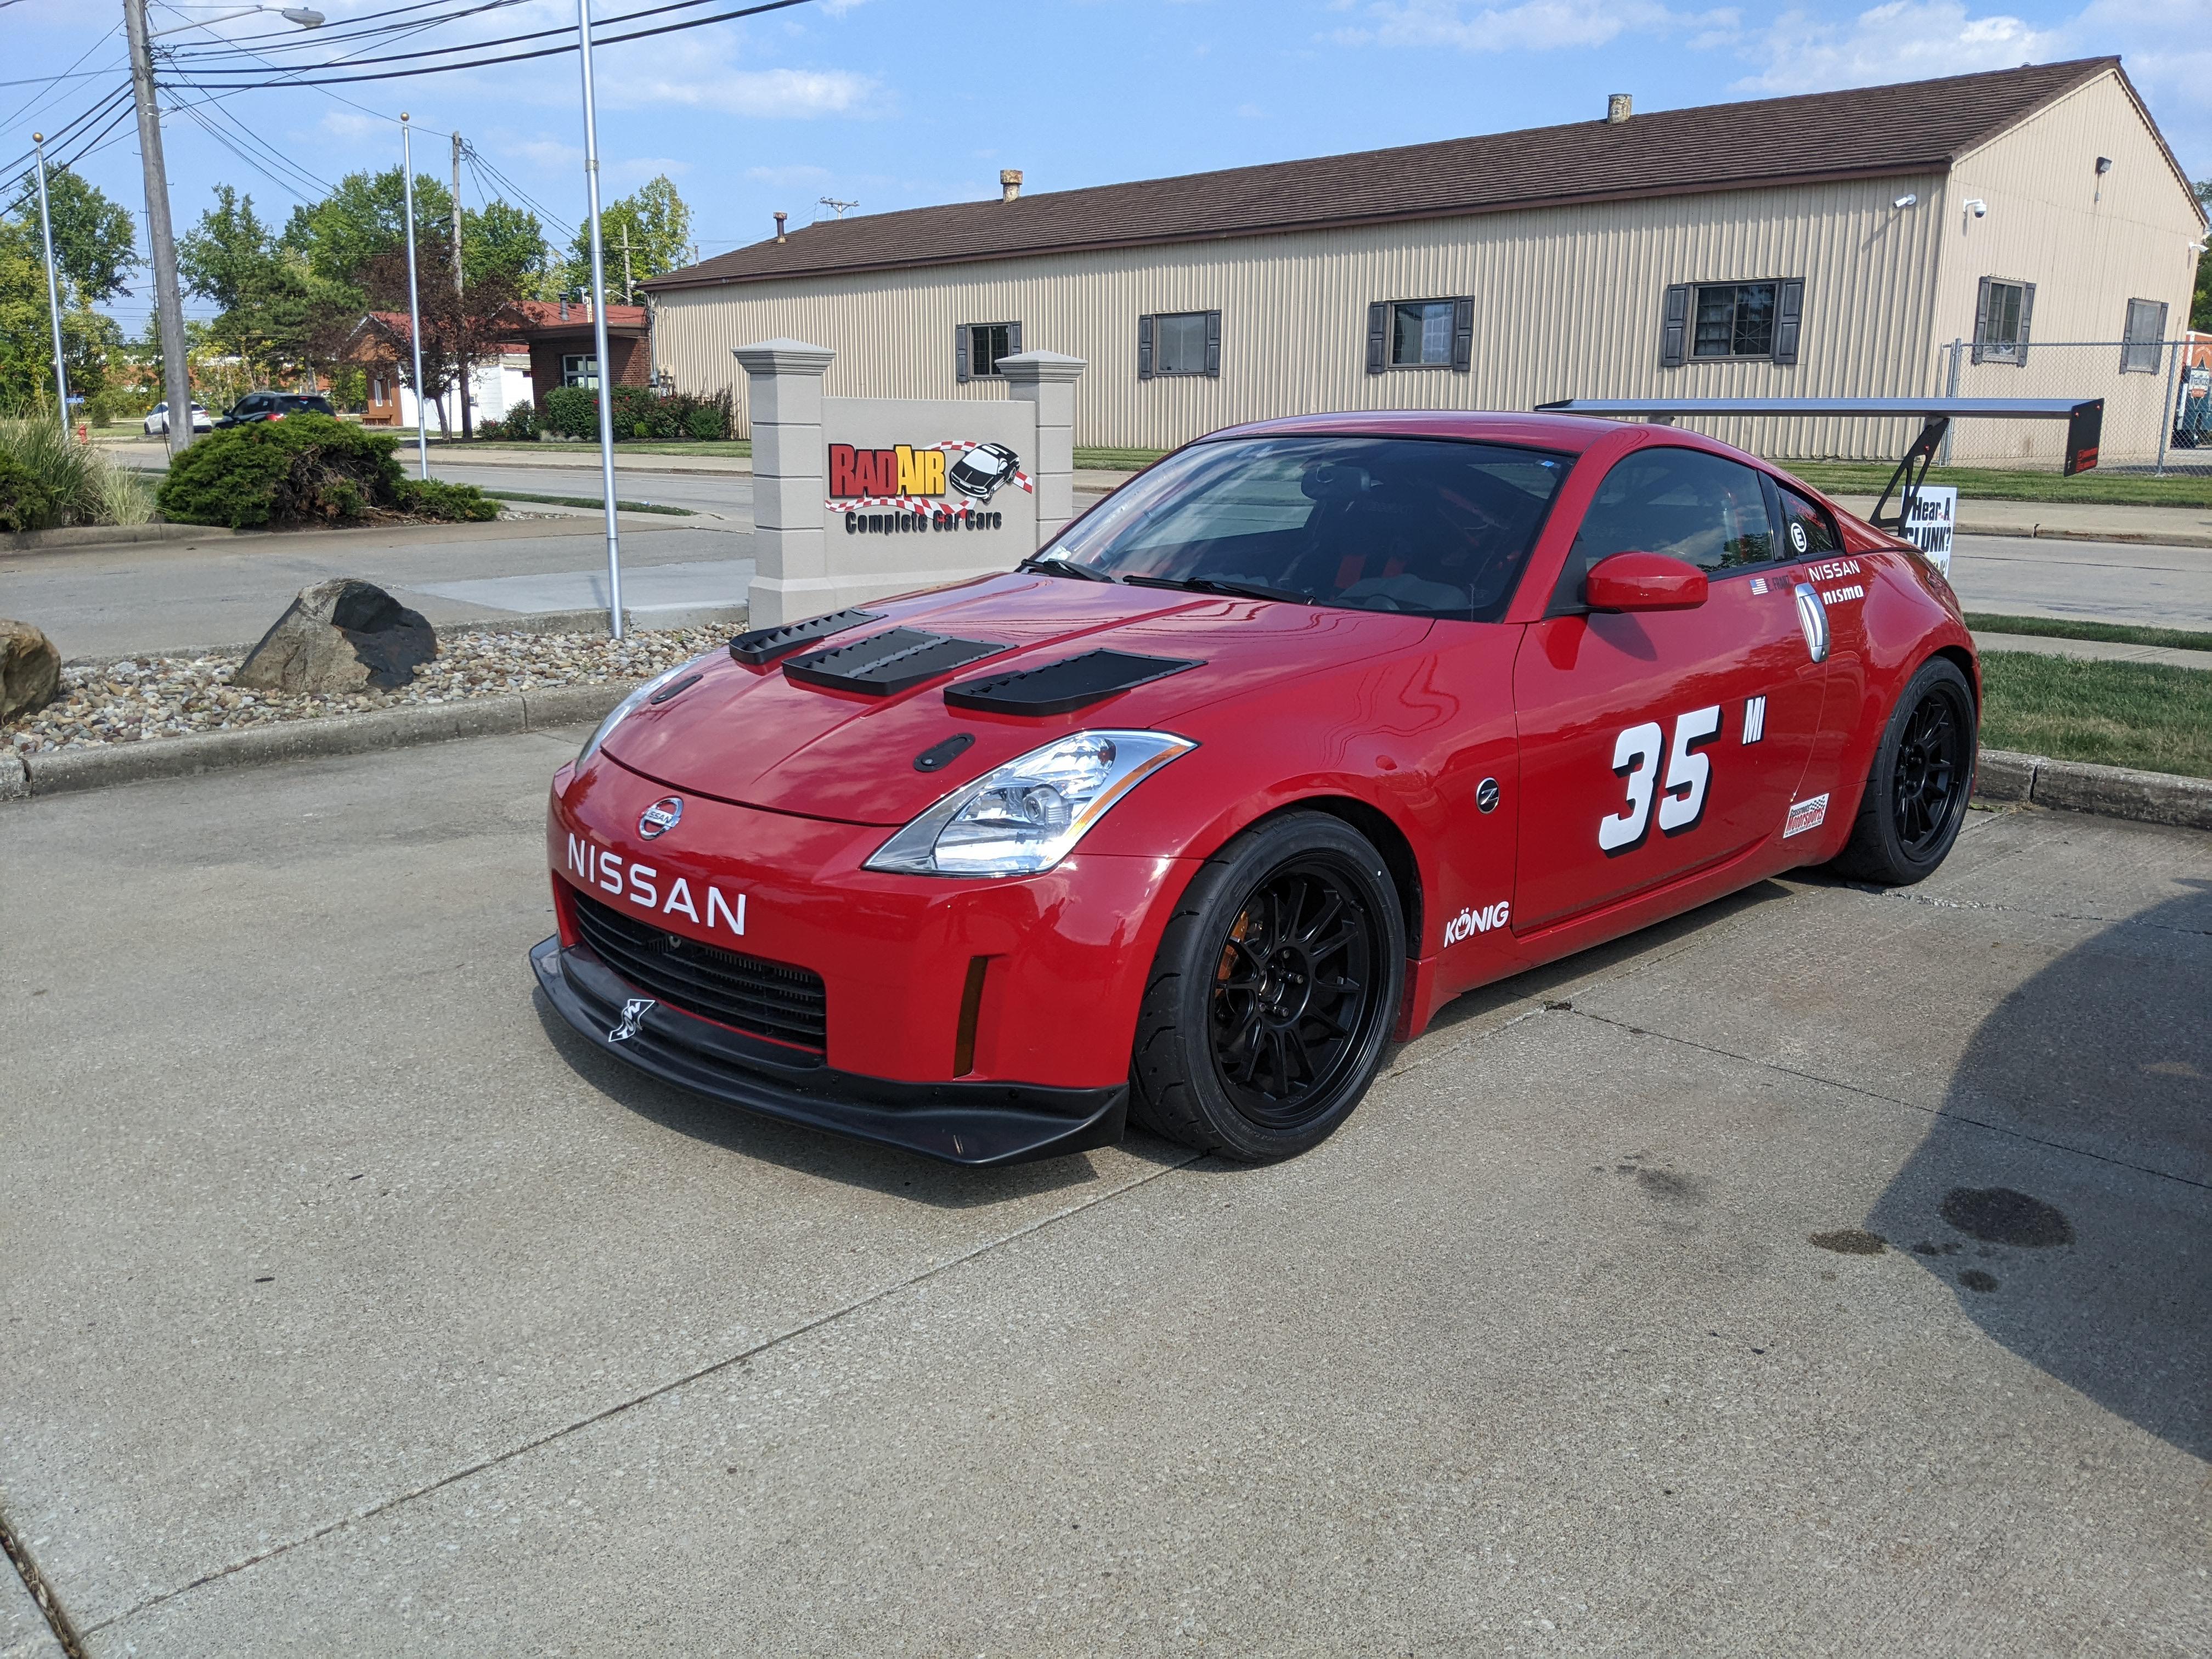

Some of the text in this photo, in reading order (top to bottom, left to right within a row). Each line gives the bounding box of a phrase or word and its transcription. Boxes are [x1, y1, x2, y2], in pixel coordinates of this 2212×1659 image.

[1911, 496, 1951, 521] Hear A
[845, 509, 1002, 535] Complete Car Care
[1809, 560, 1861, 583] NISSAN
[1822, 585, 1864, 605] nismo
[1599, 704, 1721, 854] 35
[646, 810, 673, 823] SSAN
[1786, 806, 1825, 831] Motorsports
[568, 832, 747, 935] NISSAN
[1444, 901, 1509, 948] KÖNIG
